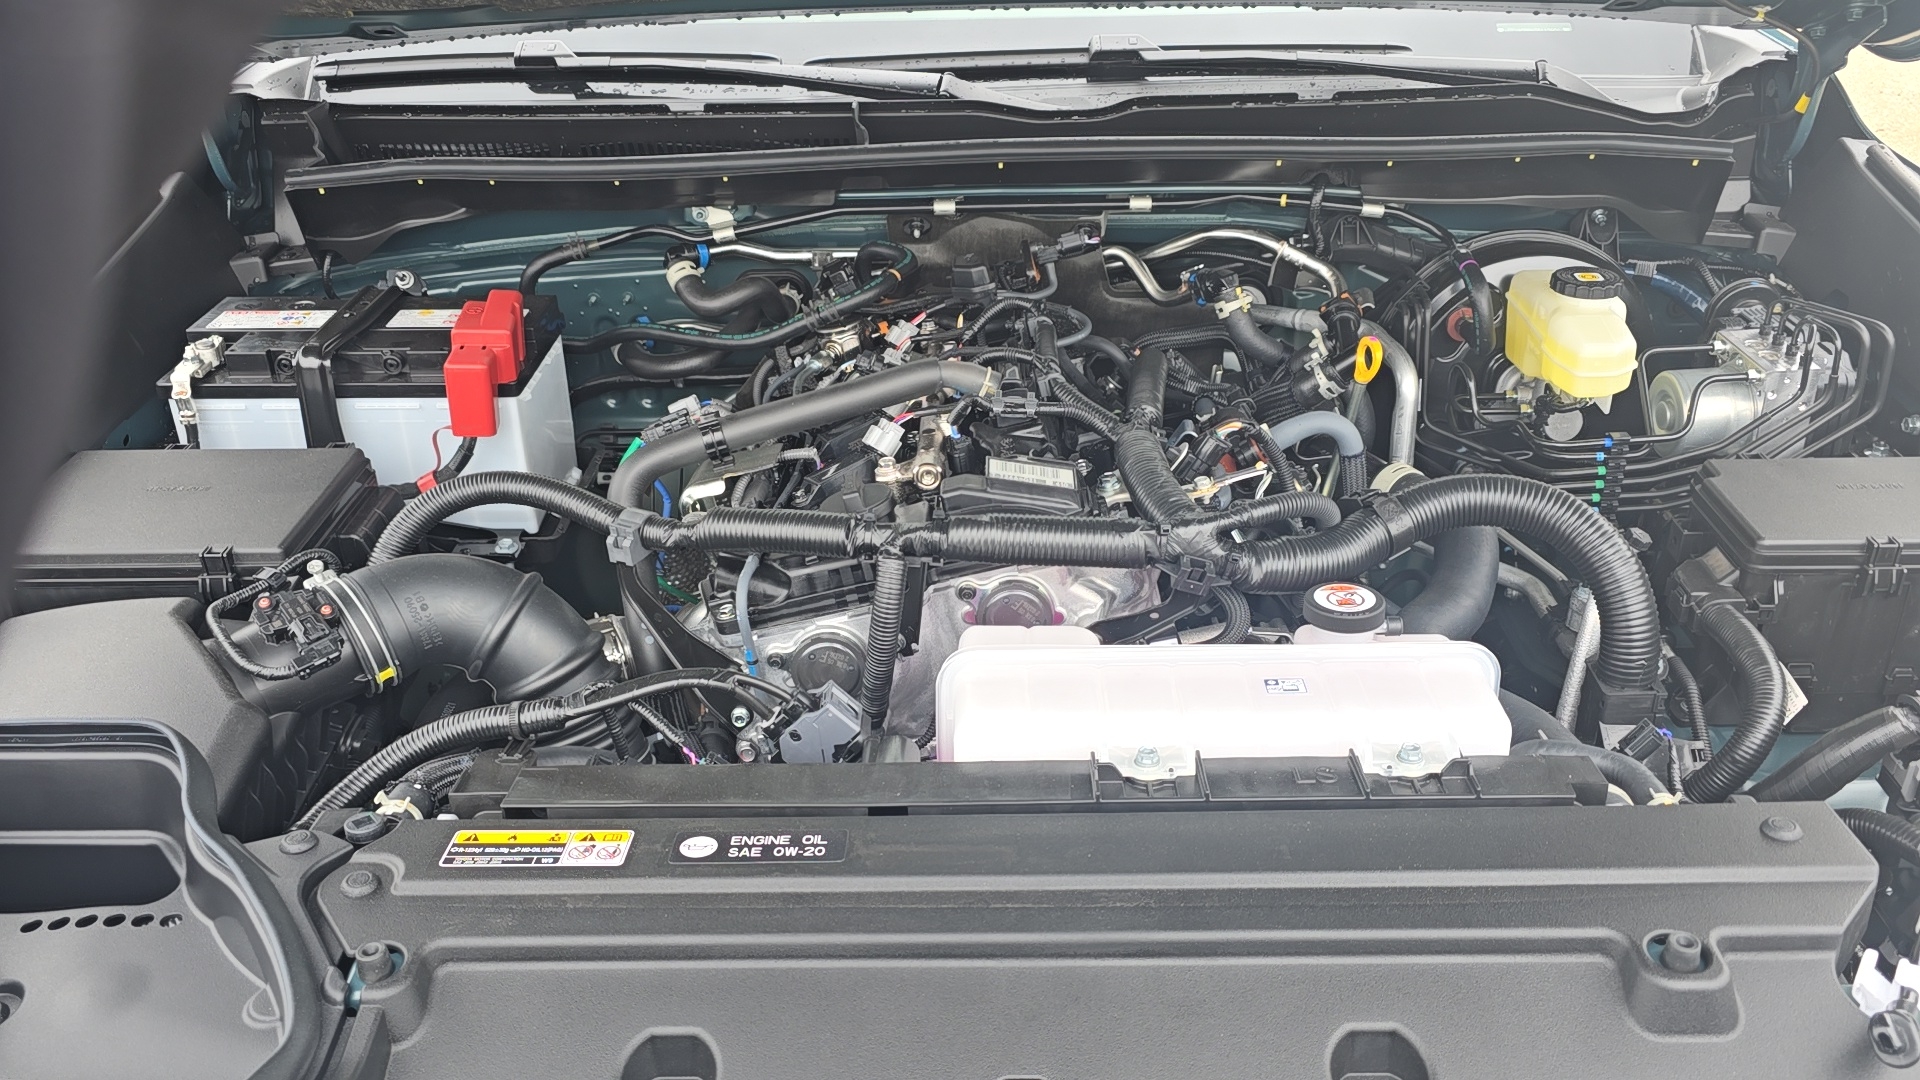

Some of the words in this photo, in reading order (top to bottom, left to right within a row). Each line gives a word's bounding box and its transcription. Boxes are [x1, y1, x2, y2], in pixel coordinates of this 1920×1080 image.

[730, 835, 791, 846] ENGINE
[801, 835, 828, 845] OIL
[727, 847, 763, 857] SAE
[773, 846, 826, 857] 0W-20
